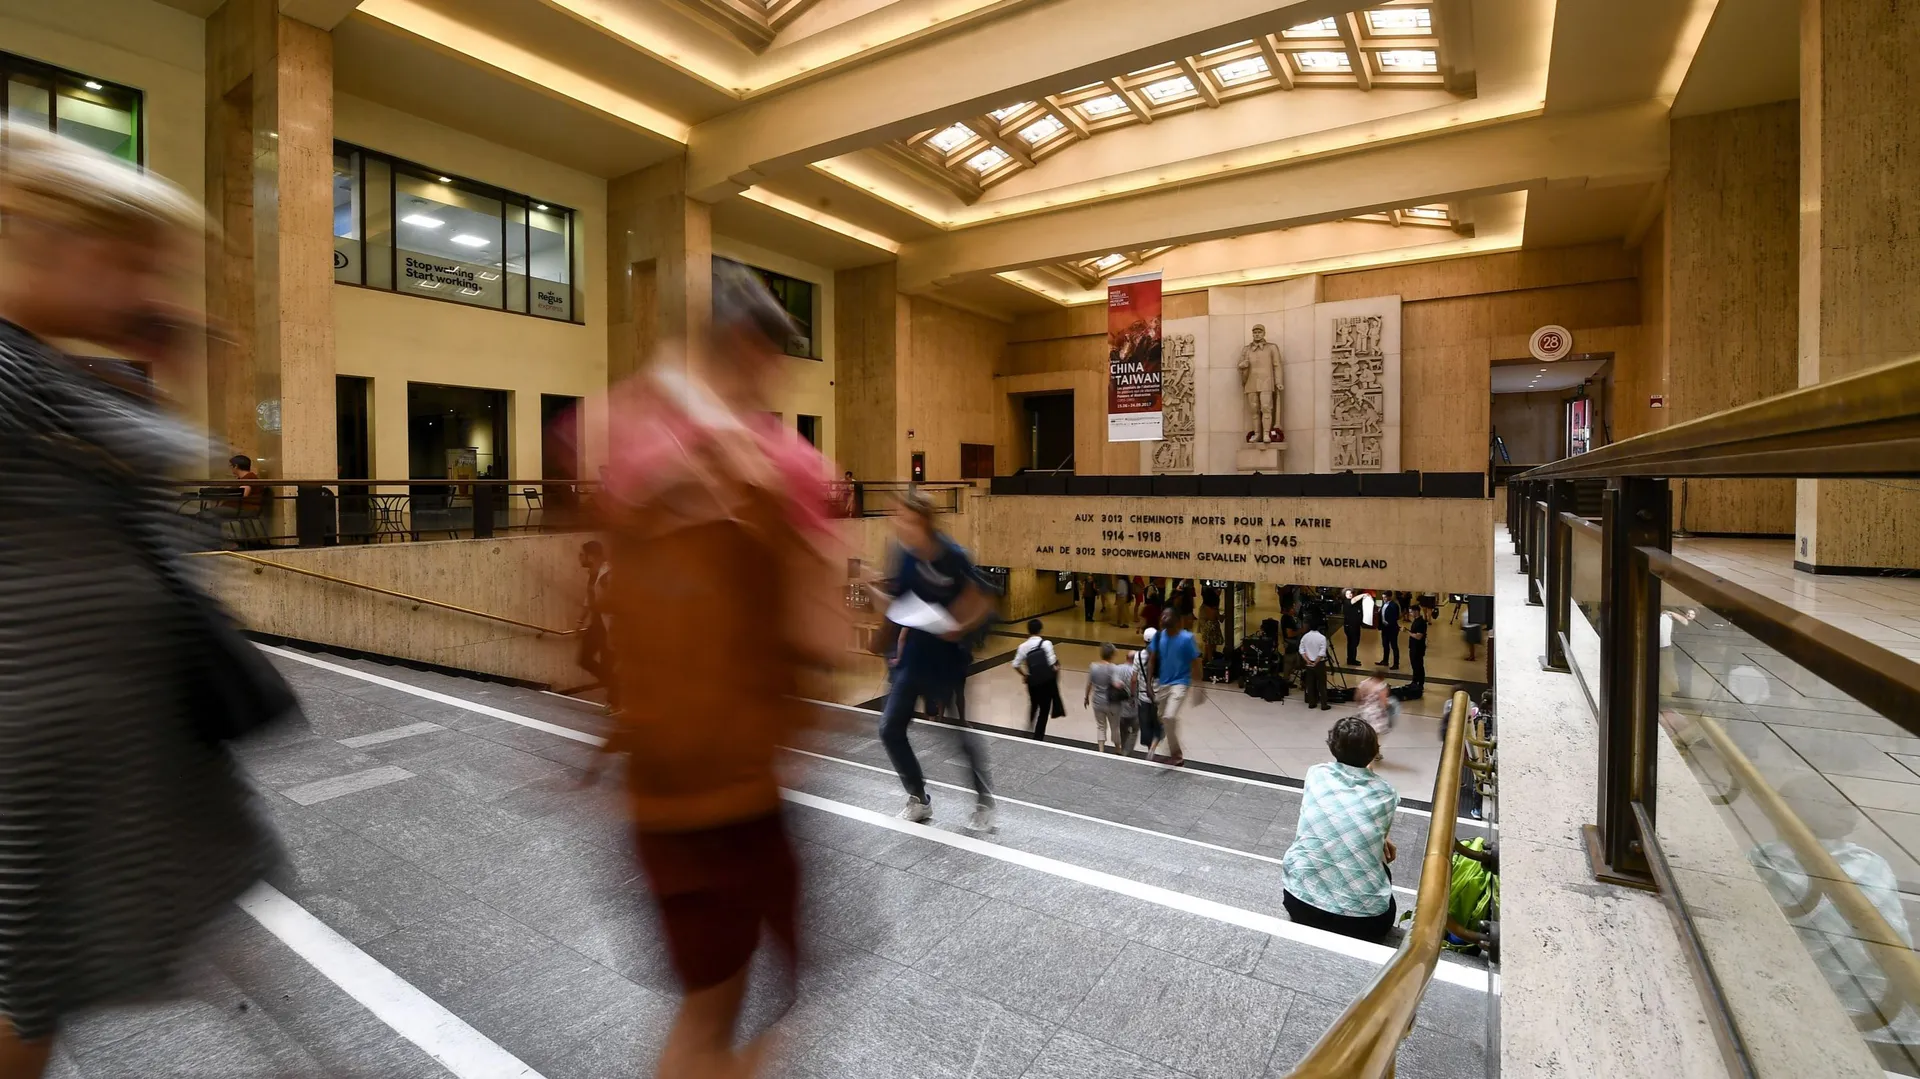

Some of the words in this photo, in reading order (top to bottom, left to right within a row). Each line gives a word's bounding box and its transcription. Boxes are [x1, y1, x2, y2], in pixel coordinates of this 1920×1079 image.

[406, 257, 432, 272] Stop
[434, 264, 474, 280] walking
[406, 268, 434, 281] Start
[538, 291, 563, 305] Regus
[1543, 336, 1559, 349] 28
[1110, 362, 1144, 374] CHINA
[1115, 372, 1160, 386] TAIWAN
[1074, 514, 1094, 522] AUX
[1101, 514, 1122, 523] 3012
[1130, 515, 1184, 524] CHEMINOTS
[1191, 516, 1226, 525] MORTS
[1234, 517, 1263, 526] POUR
[1271, 518, 1286, 527] LA
[1295, 518, 1331, 528] PATRIE
[1102, 530, 1124, 541] 1914
[1138, 531, 1161, 542] 1918
[1220, 534, 1250, 545] 1940
[1266, 535, 1297, 547] 1945
[1076, 547, 1095, 556] 3012
[1102, 548, 1190, 560] SPOORWEGMANNEN
[1198, 552, 1246, 563] GEVALLEN
[1254, 555, 1285, 564] VOOR
[1293, 556, 1311, 566] HET
[1320, 557, 1387, 569] VADERLAND
